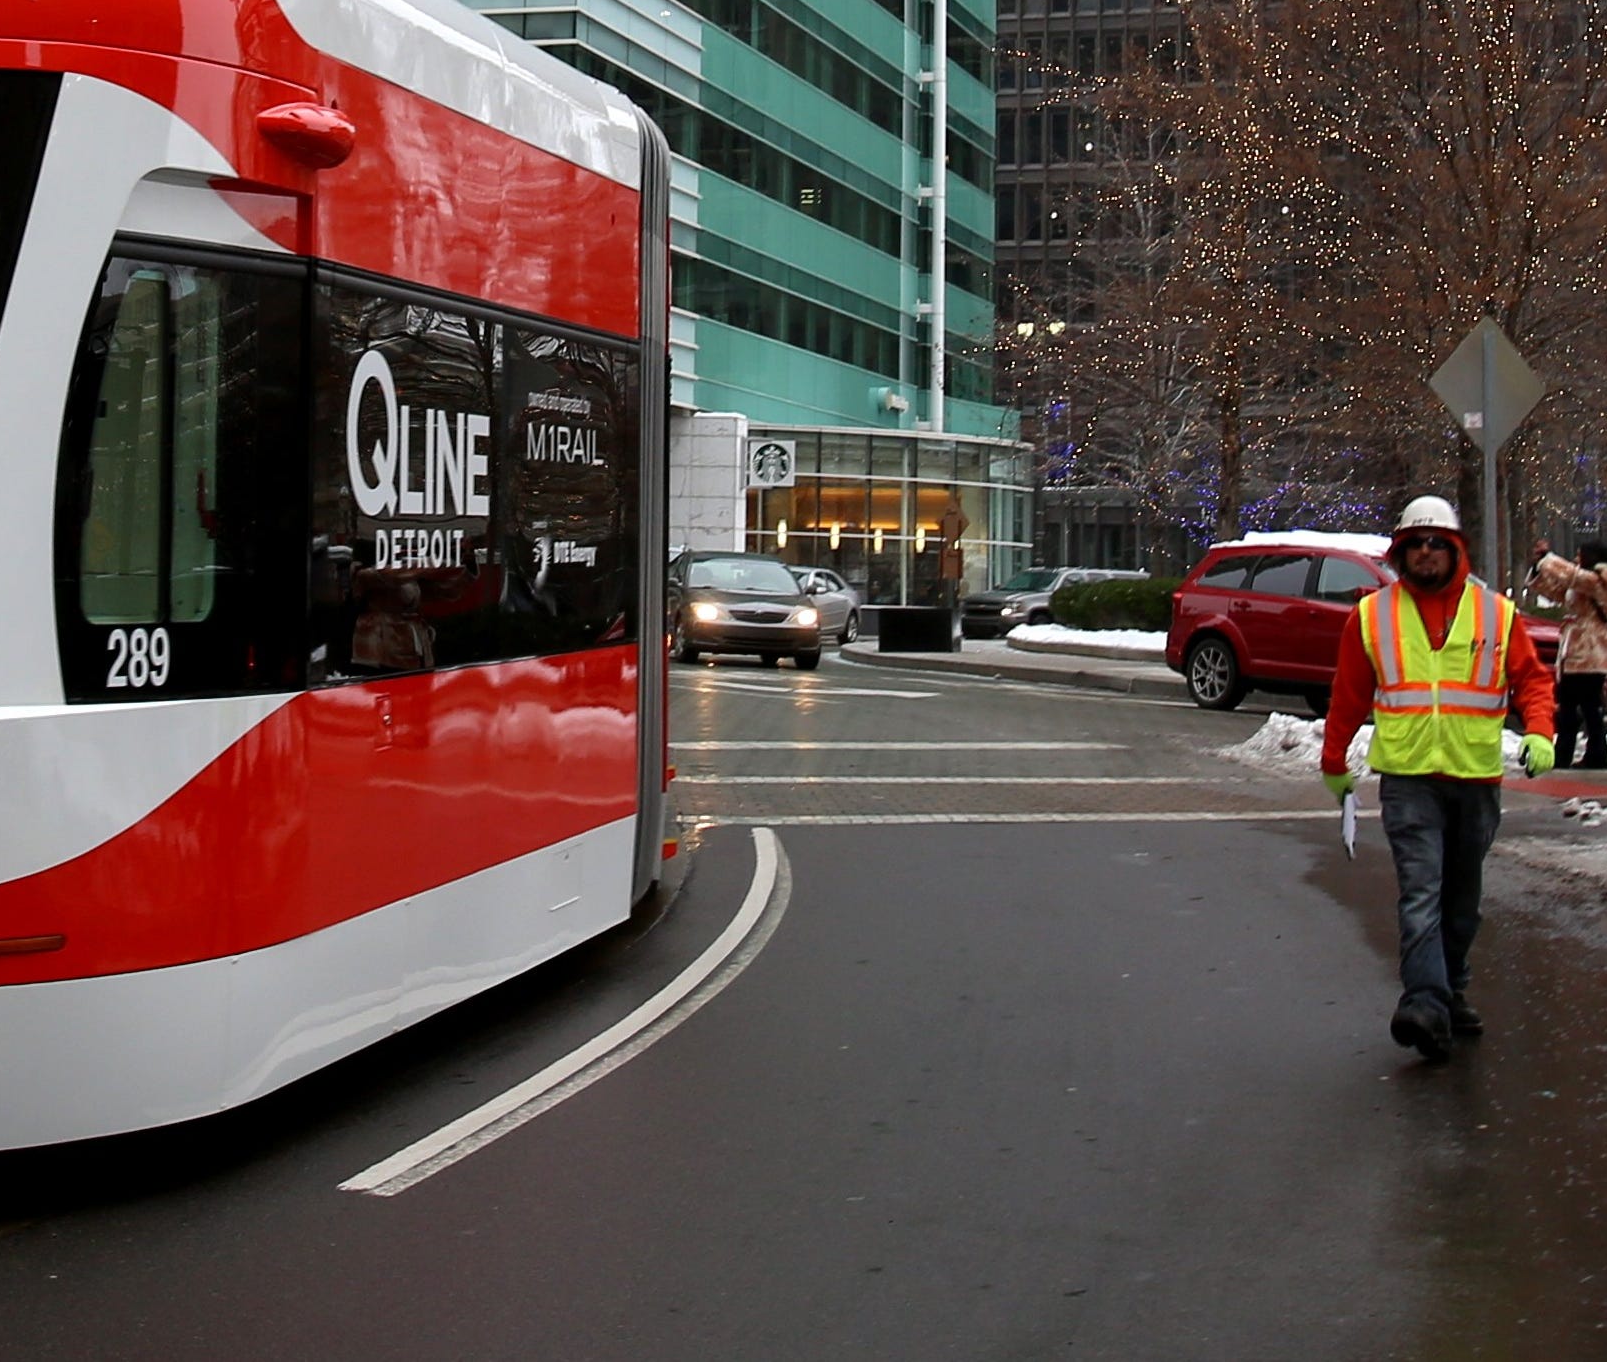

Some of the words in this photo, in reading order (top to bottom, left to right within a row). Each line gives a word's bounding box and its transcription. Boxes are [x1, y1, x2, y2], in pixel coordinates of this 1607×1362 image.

[346, 349, 491, 517] QLINE
[526, 422, 605, 466] M1RAIL
[375, 529, 465, 570] DETROIT
[106, 627, 170, 688] 289
